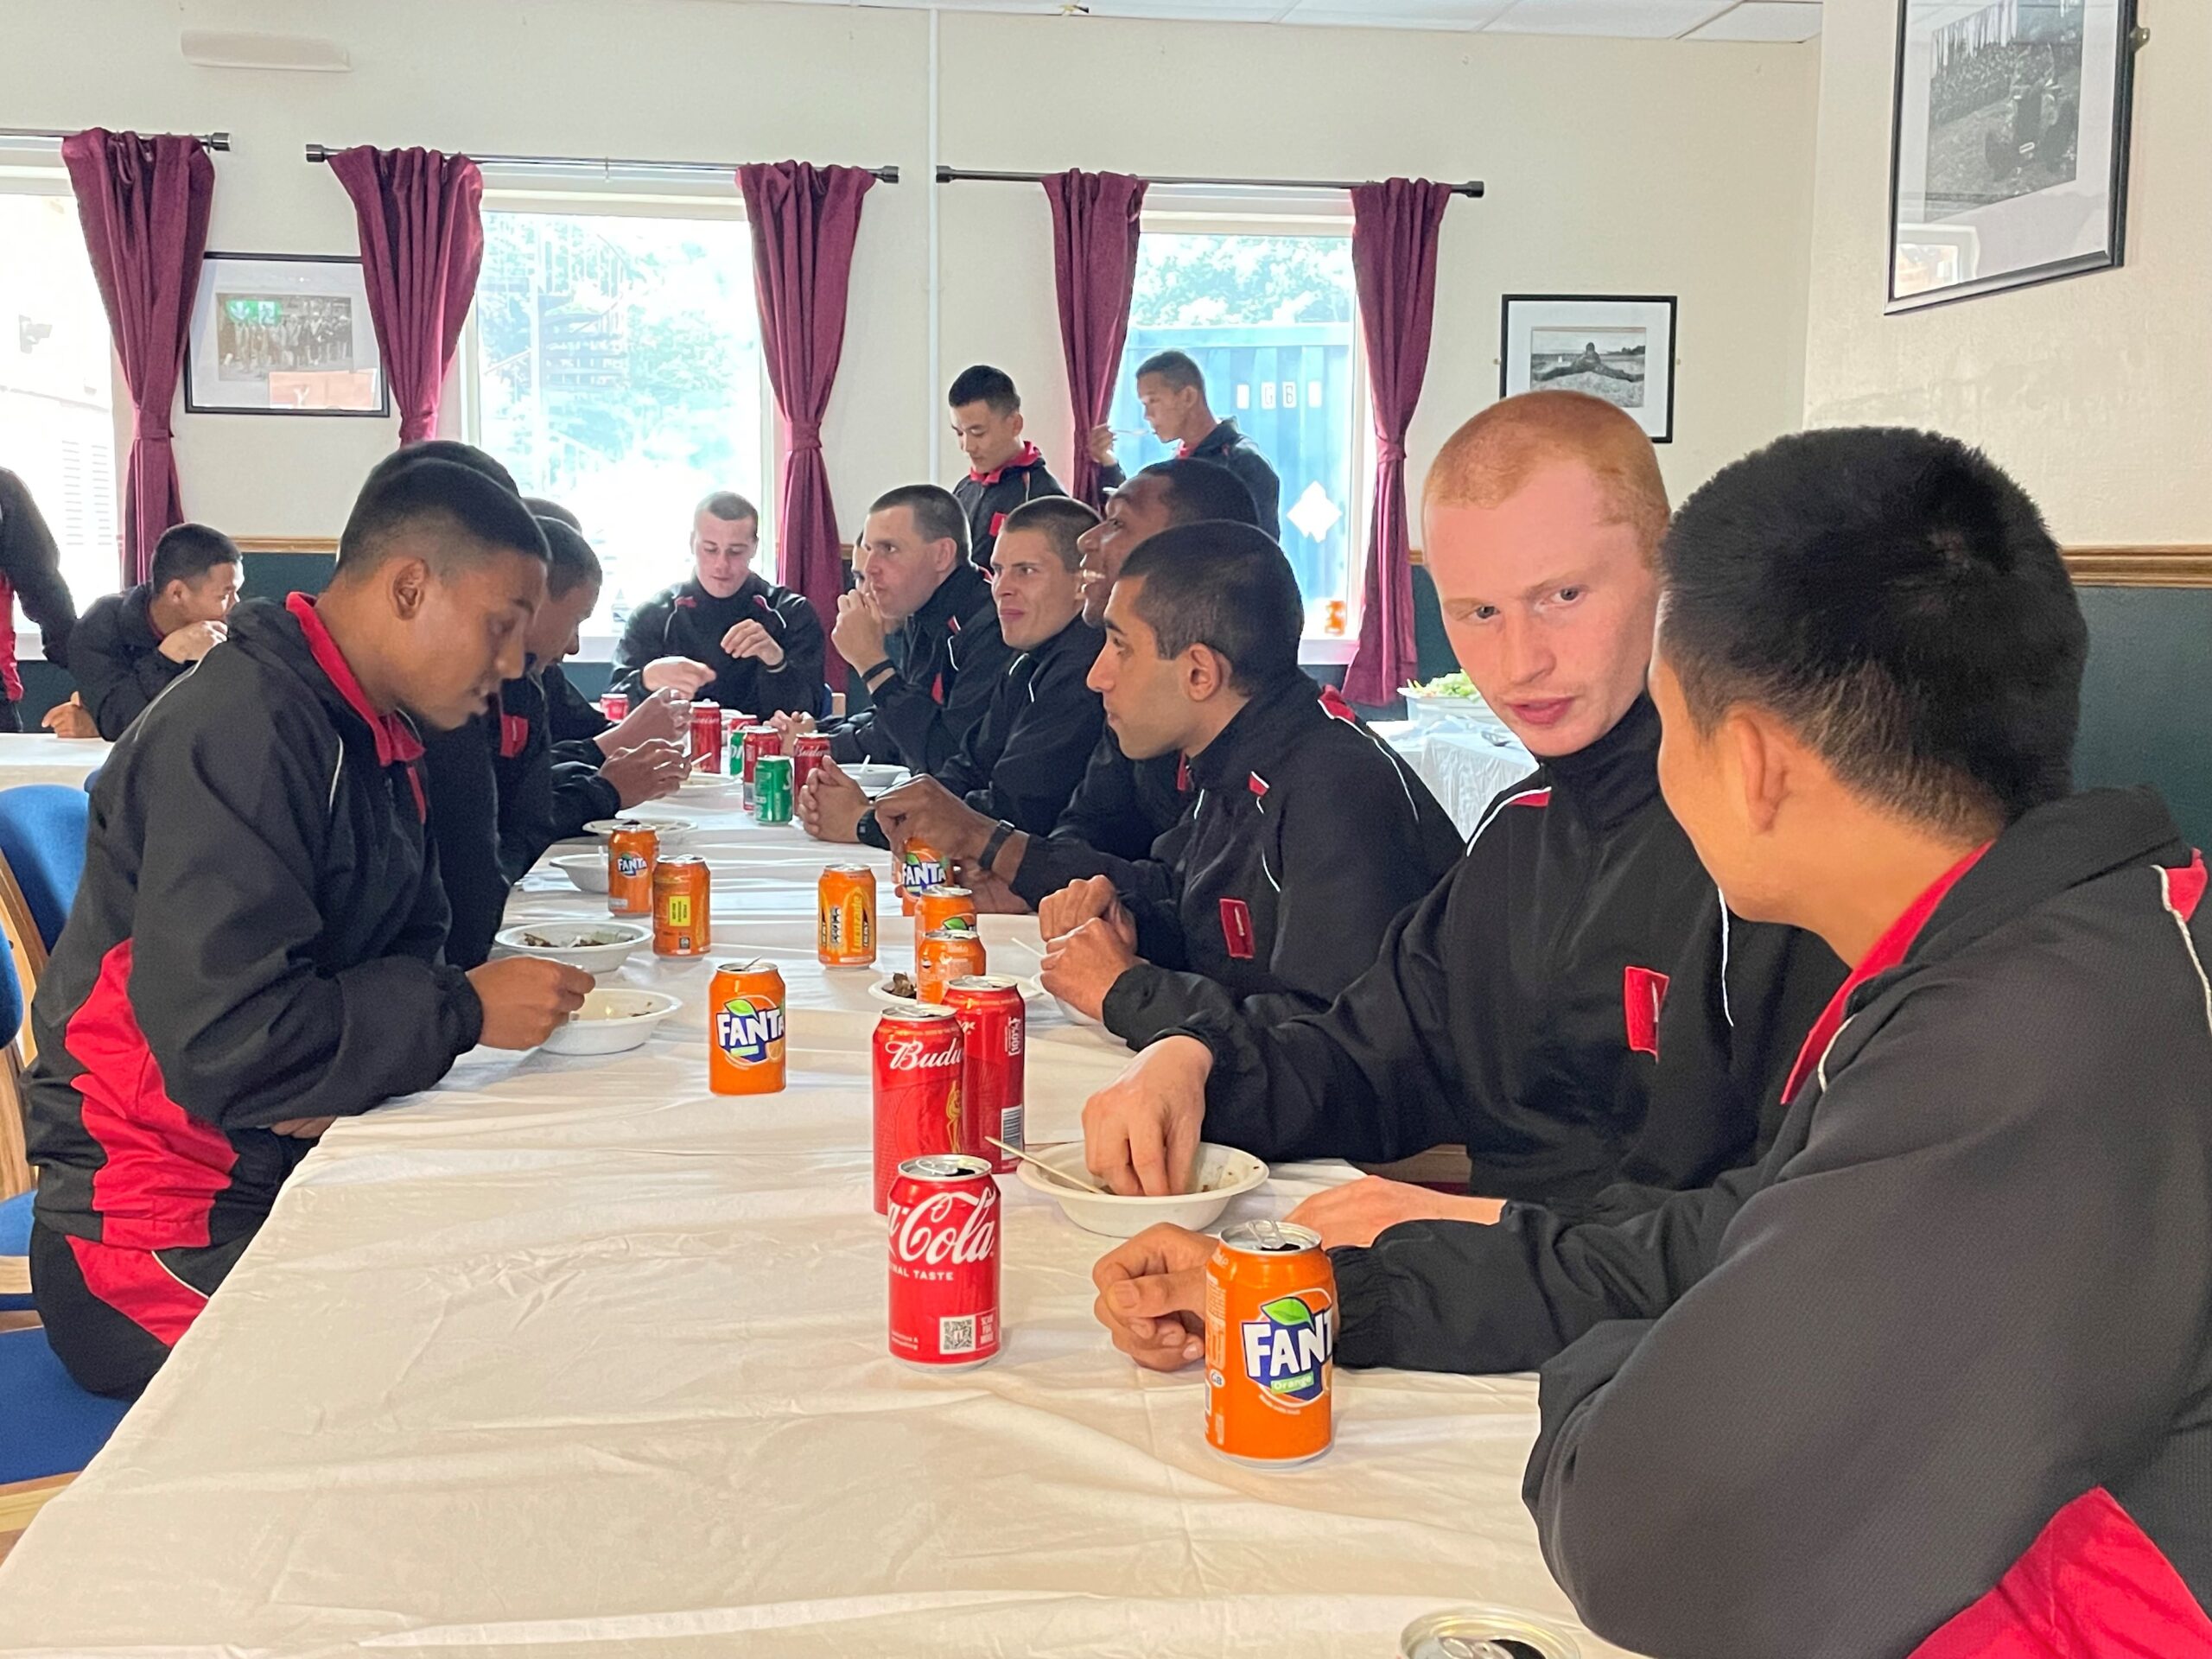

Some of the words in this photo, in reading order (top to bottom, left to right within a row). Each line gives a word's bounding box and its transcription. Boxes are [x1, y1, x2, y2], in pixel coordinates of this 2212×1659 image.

[617, 857, 648, 871] FANTA
[912, 1270, 955, 1281] TASTE
[1274, 1374, 1312, 1390] Orange
